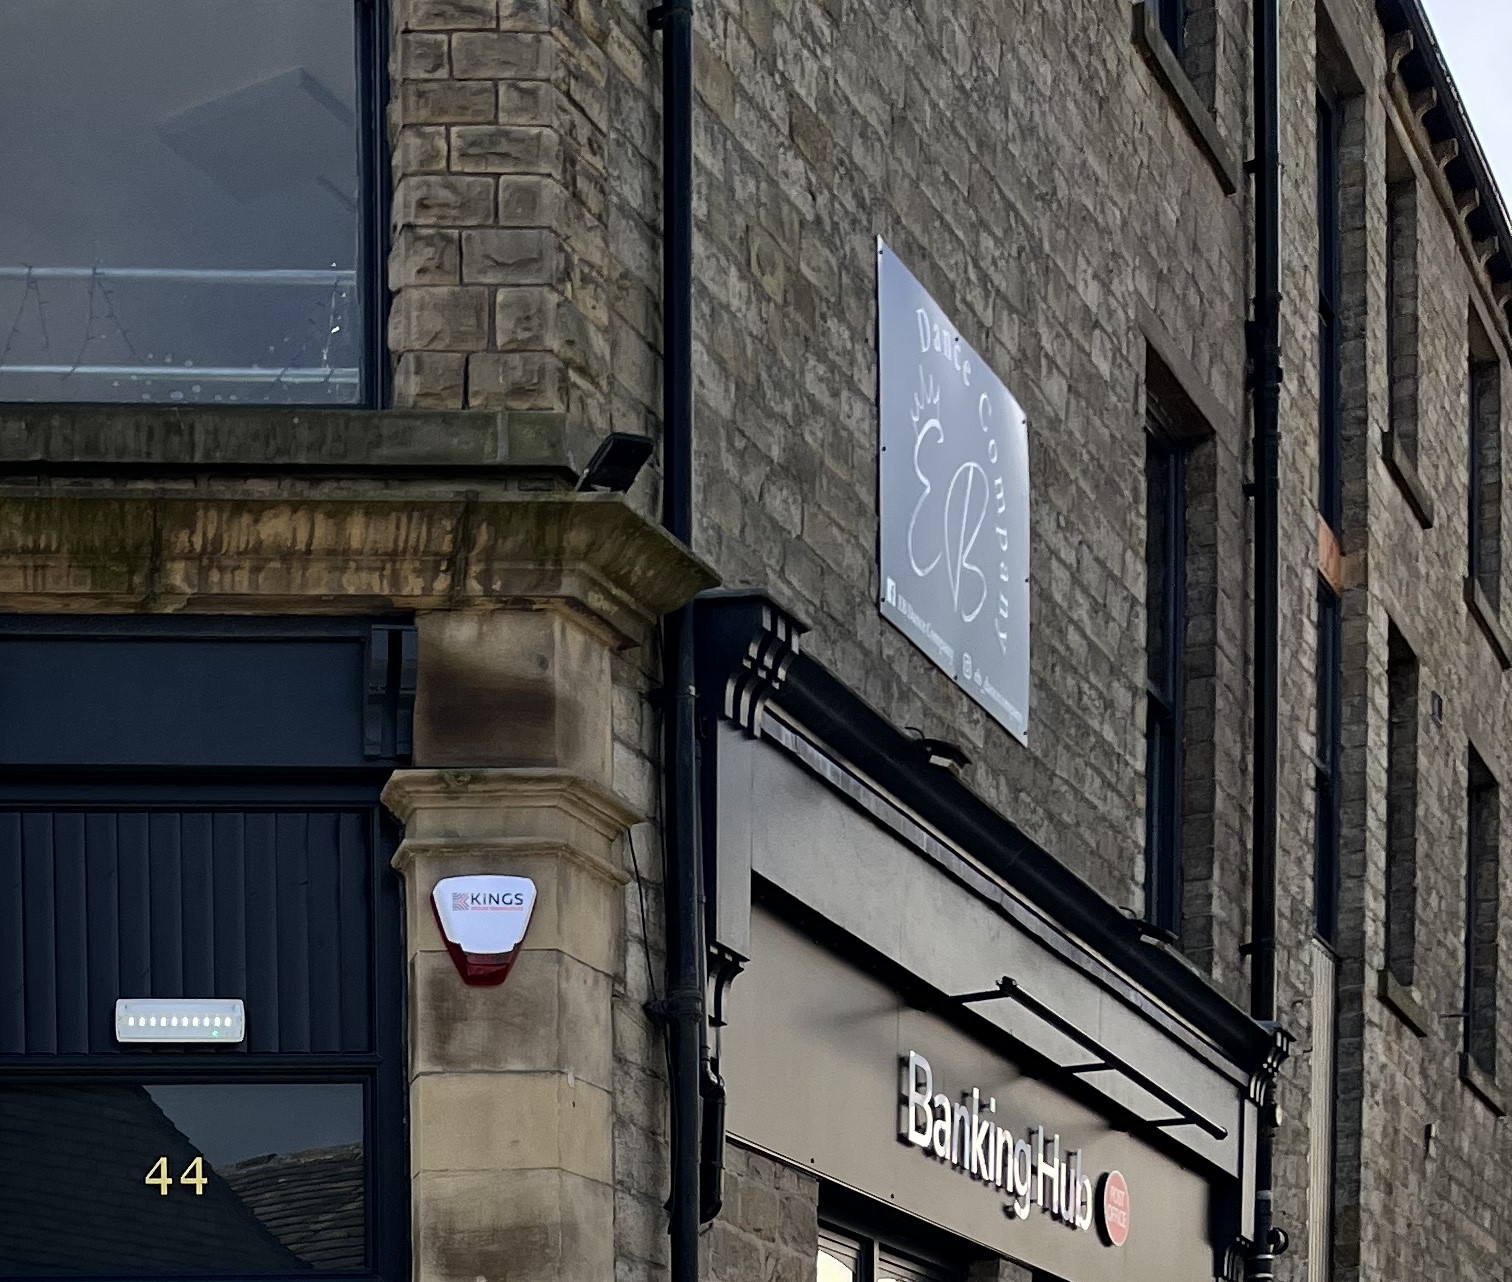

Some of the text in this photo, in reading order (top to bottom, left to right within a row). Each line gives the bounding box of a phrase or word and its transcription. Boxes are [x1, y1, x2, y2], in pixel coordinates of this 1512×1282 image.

[916, 308, 972, 387] Dance
[978, 391, 1010, 656] Company
[470, 892, 524, 906] KINGS
[144, 1156, 208, 1196] 44
[908, 1049, 1093, 1231] Banking Hub
